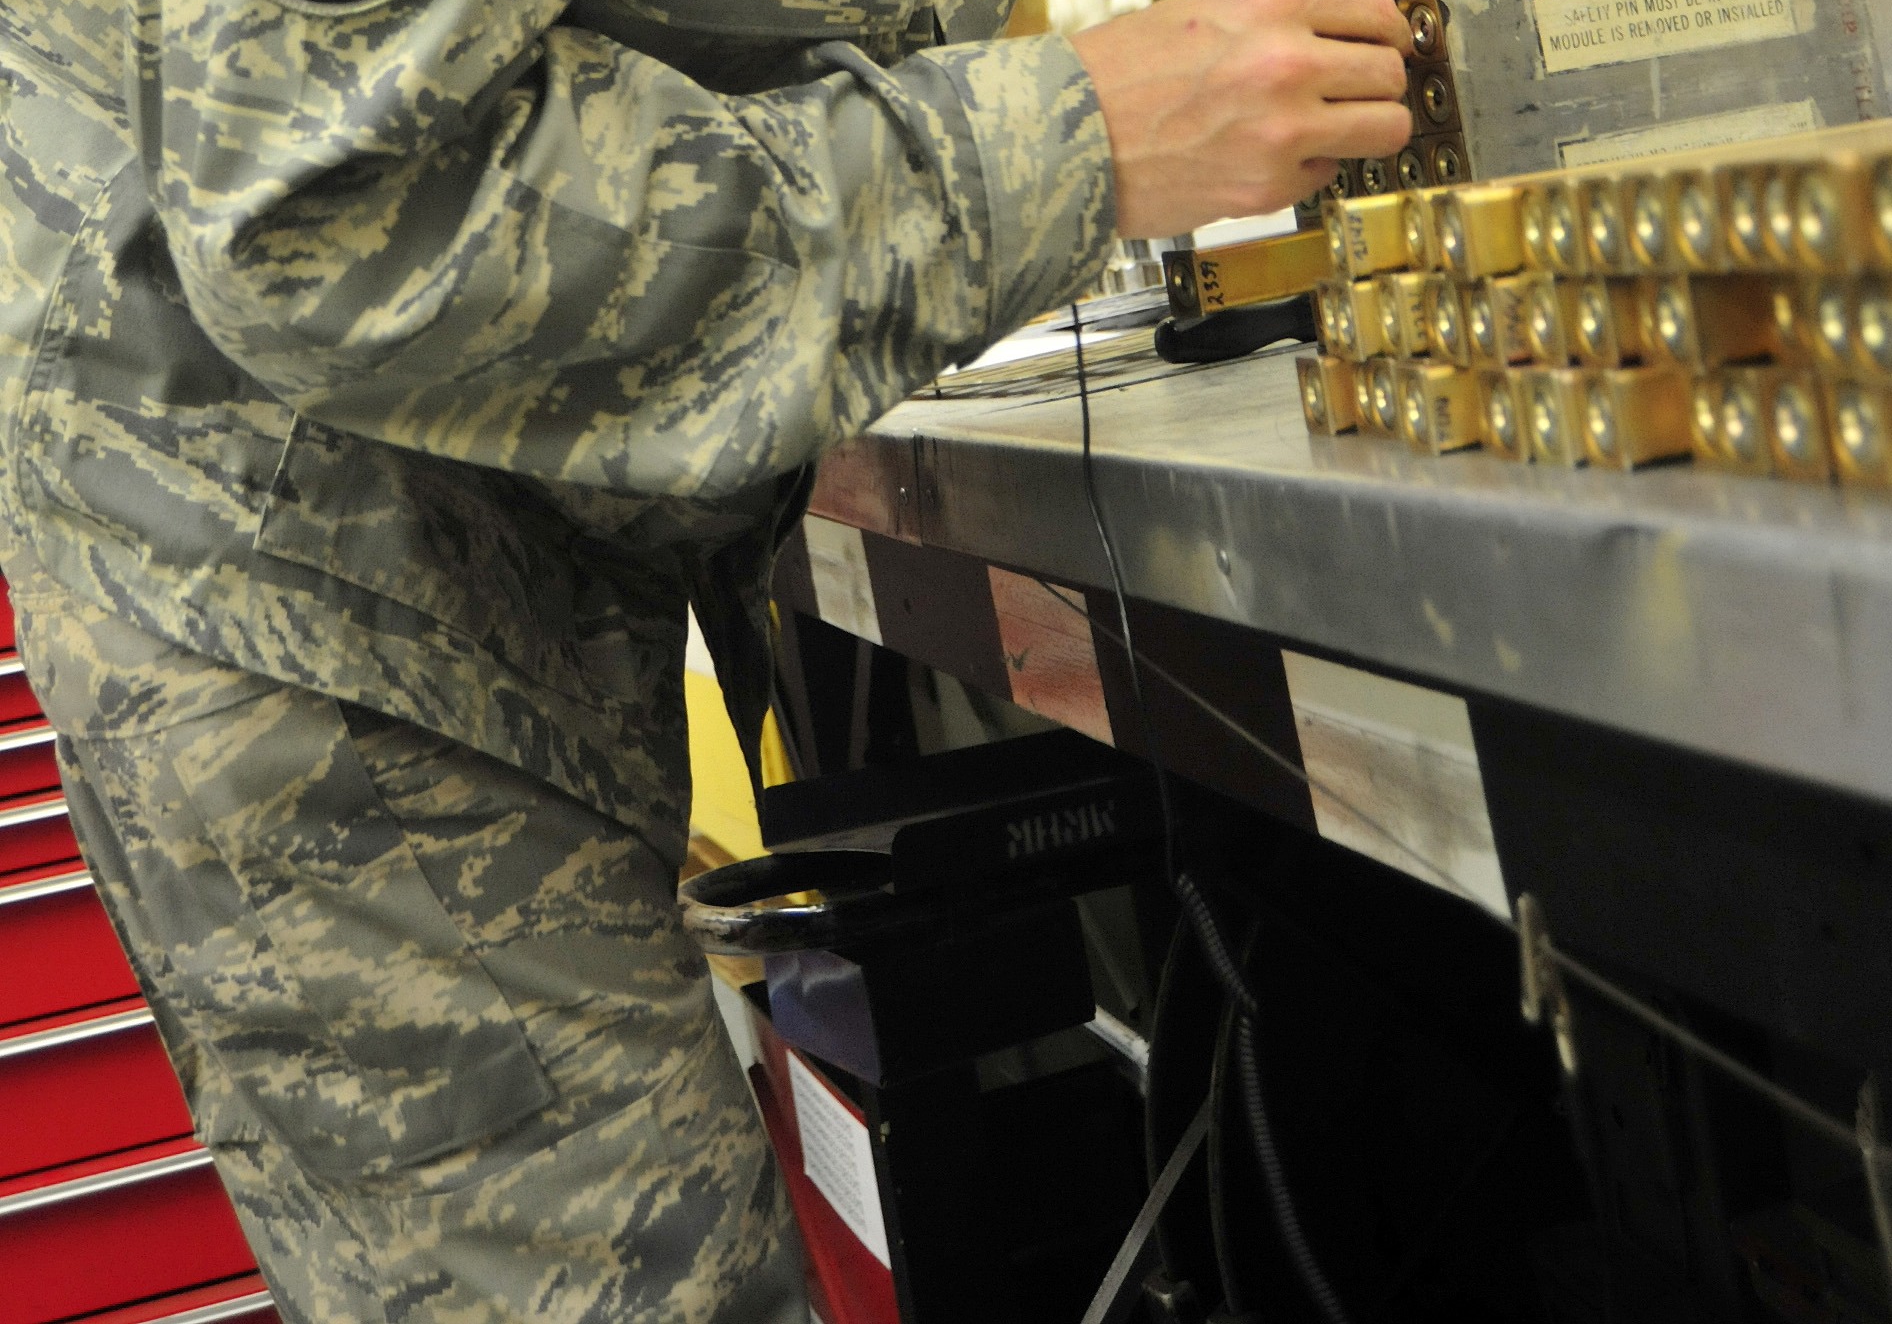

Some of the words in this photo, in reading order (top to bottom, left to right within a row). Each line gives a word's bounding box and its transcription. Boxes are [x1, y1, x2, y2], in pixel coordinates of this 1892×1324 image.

[1550, 29, 1606, 52] MODULE
[1611, 25, 1624, 42] IS
[1629, 14, 1690, 39] REMOVED
[1695, 10, 1712, 27] OR
[1718, 0, 1784, 24] INSTALLED
[1564, 4, 1610, 26] SAFETY
[1616, 0, 1639, 18] PIN
